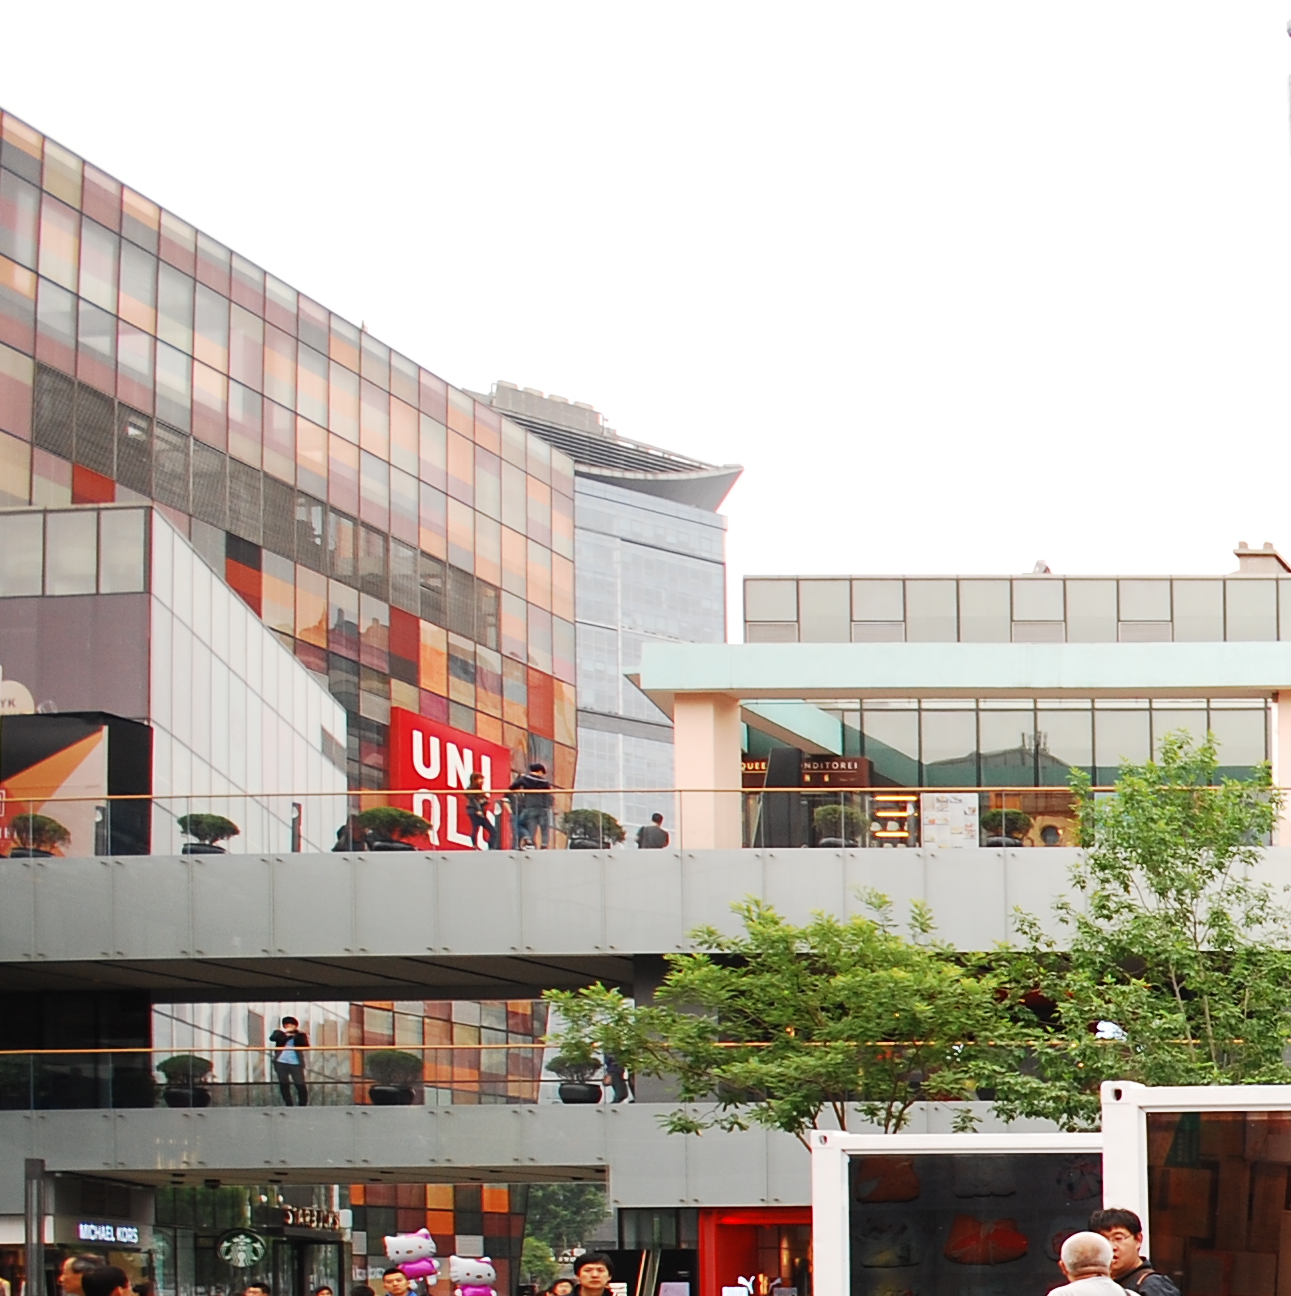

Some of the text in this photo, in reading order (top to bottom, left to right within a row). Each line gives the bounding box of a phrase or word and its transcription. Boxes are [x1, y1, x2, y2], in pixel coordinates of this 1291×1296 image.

[412, 729, 491, 798] UNI
[801, 761, 858, 770] NDITOREI
[79, 1223, 115, 1242] MICHAEL
